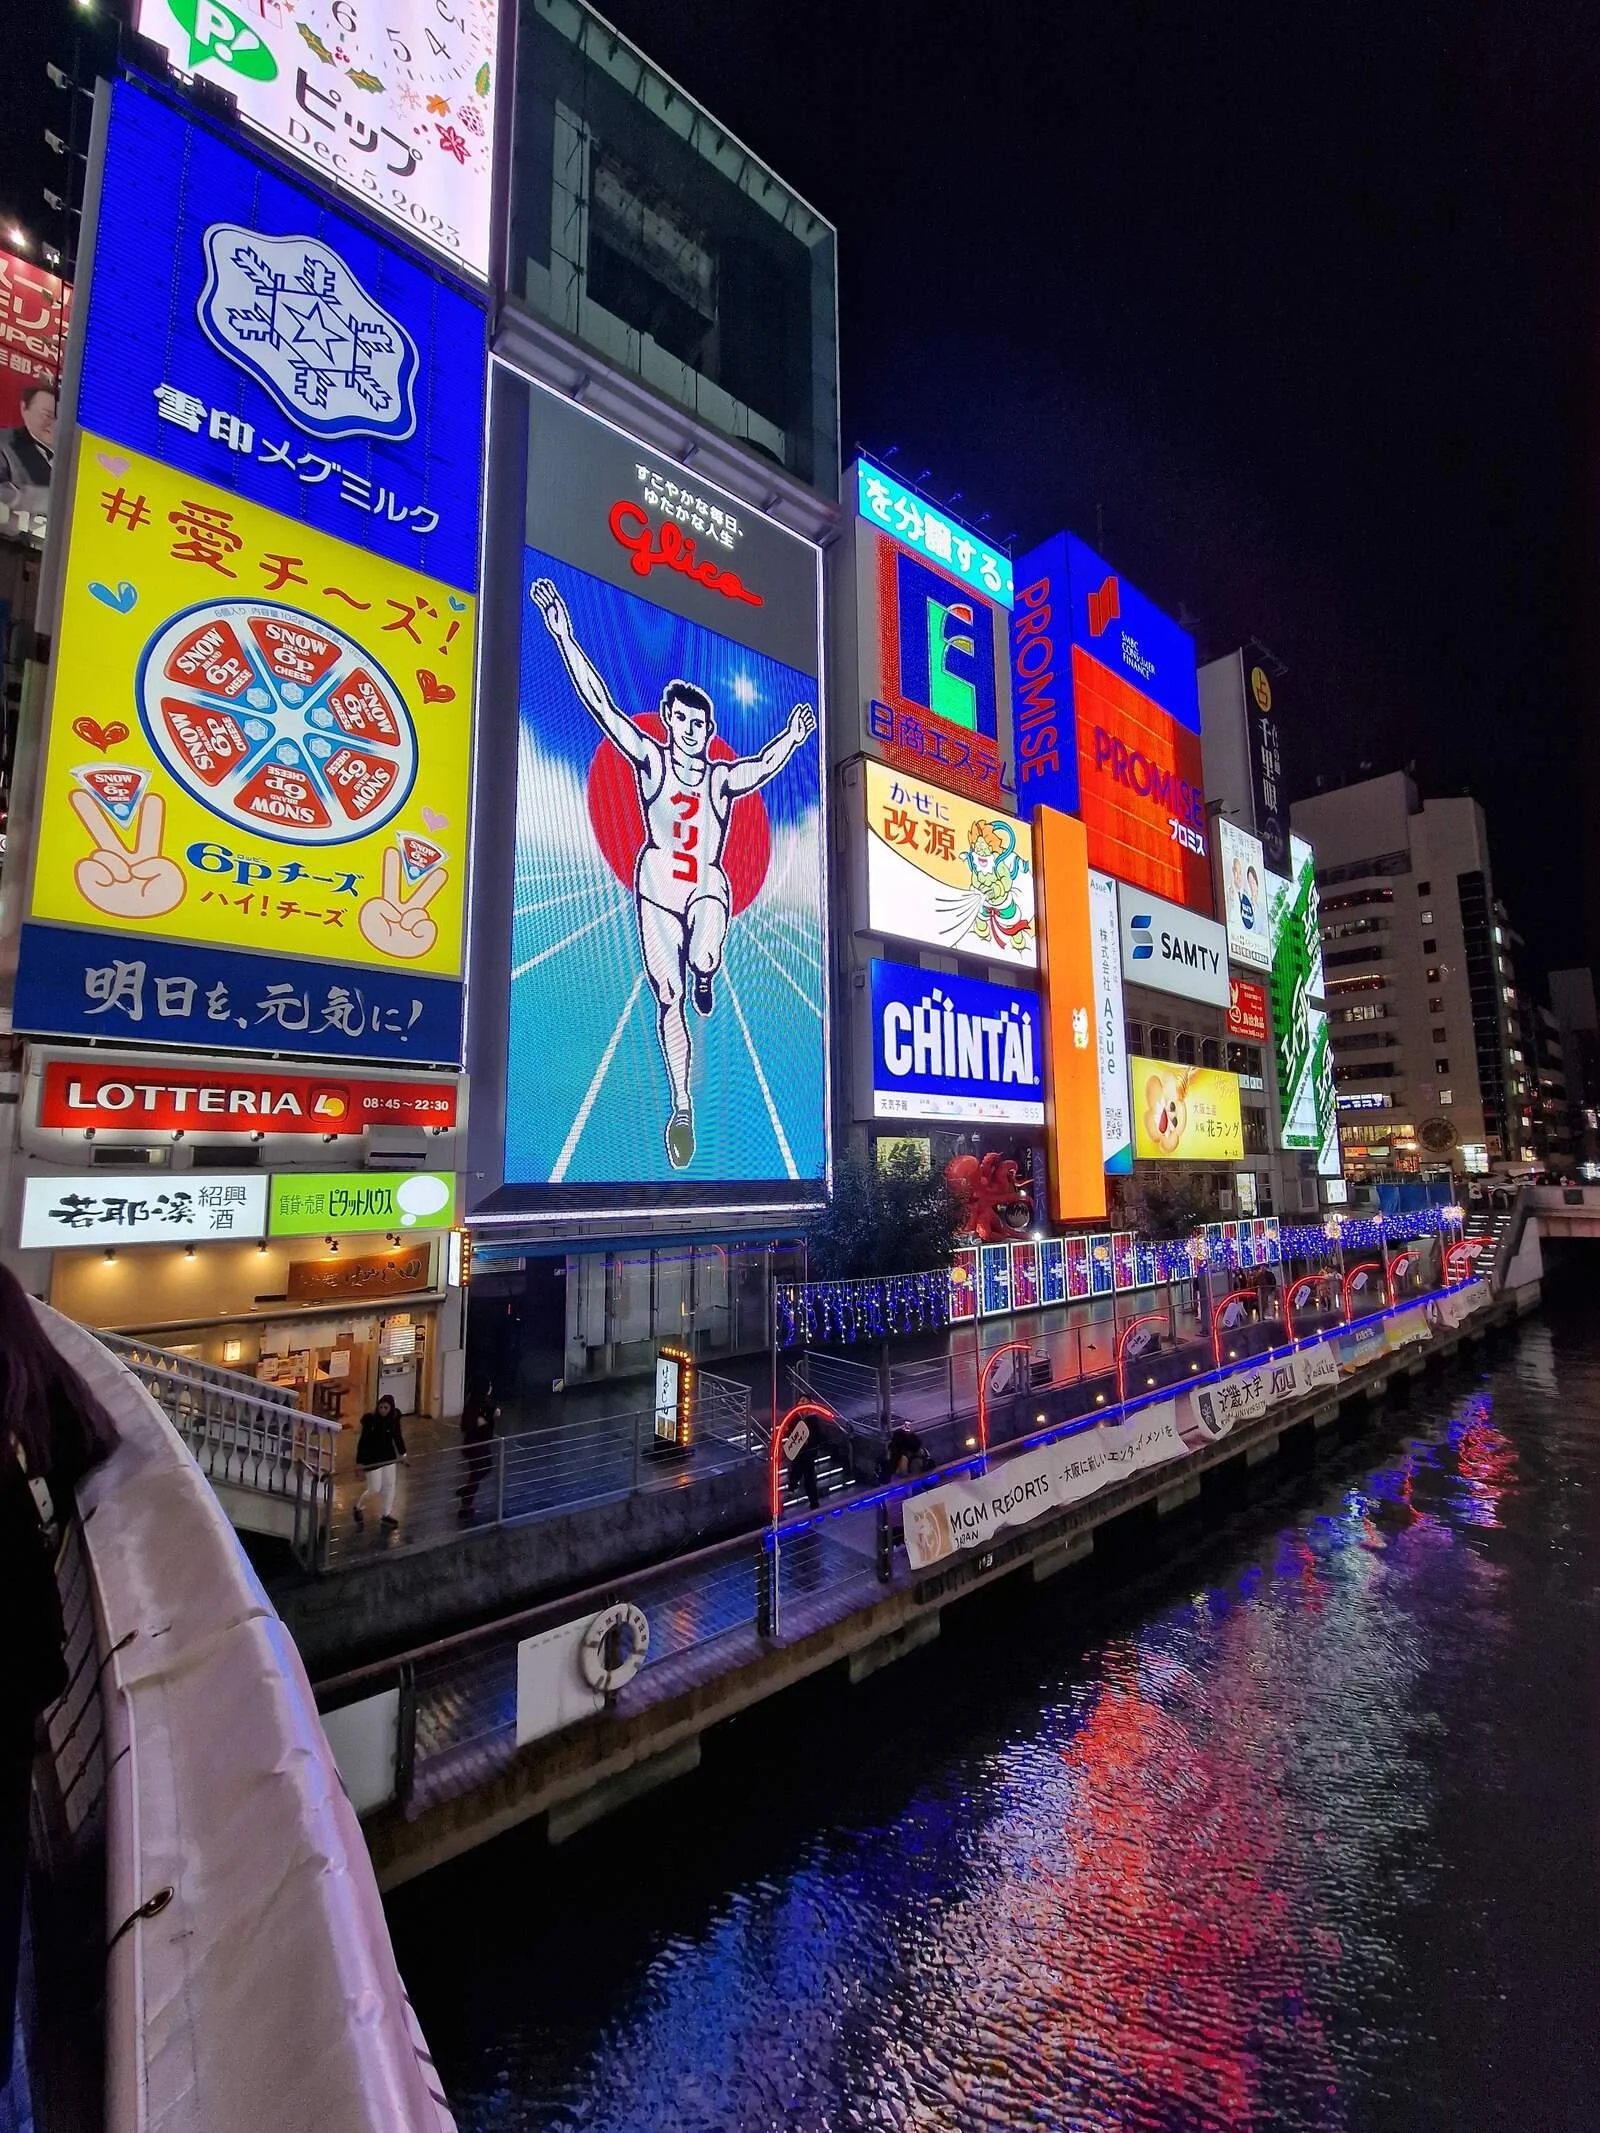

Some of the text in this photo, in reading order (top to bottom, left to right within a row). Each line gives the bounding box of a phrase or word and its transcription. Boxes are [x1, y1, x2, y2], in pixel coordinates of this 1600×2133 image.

[332, 0, 357, 32] 6
[386, 27, 412, 62] 5
[424, 27, 451, 59] 4
[295, 66, 424, 178] ピップ
[288, 116, 355, 178] Dec.
[391, 188, 461, 248] 2023
[153, 382, 440, 534] 雪印メグミルク
[635, 463, 744, 537] すこやかな毎日、
[644, 486, 735, 549] ゆたかな人生
[608, 499, 764, 607] Glico
[176, 628, 225, 675] SNOW
[265, 623, 329, 656] SNOW
[282, 643, 310, 657] BRAND
[1121, 630, 1139, 652] SMBC
[224, 668, 253, 696] CHEESE
[274, 665, 313, 683] CHEESE
[1015, 577, 1060, 783] PROMISE
[1122, 652, 1150, 680] FINANCE
[358, 682, 395, 735] SNOW
[167, 711, 216, 771] SNOW
[94, 773, 133, 783] SNOW
[267, 765, 306, 782] CHEESE
[351, 767, 391, 812] SNOW
[1094, 724, 1204, 828] PROMISE
[250, 796, 315, 824] SNOW
[889, 782, 950, 821] かぜに
[669, 790, 701, 885] グリコ
[882, 804, 957, 862] 改源
[1168, 818, 1206, 857] プロミス
[199, 890, 348, 928] ハイ!チーズ
[1160, 931, 1220, 975] SAMTY
[83, 959, 424, 1042] 明日を、元気に!
[883, 987, 1034, 1085] CHINTAI
[1103, 996, 1116, 1075] Asue
[68, 1082, 303, 1116] LOTTERIA
[880, 1098, 908, 1111] 天気予報
[198, 1185, 247, 1207] 紹興
[329, 1187, 393, 1217] ピタットハウス
[209, 1208, 235, 1230] 酒
[949, 1504, 989, 1534] MGM
